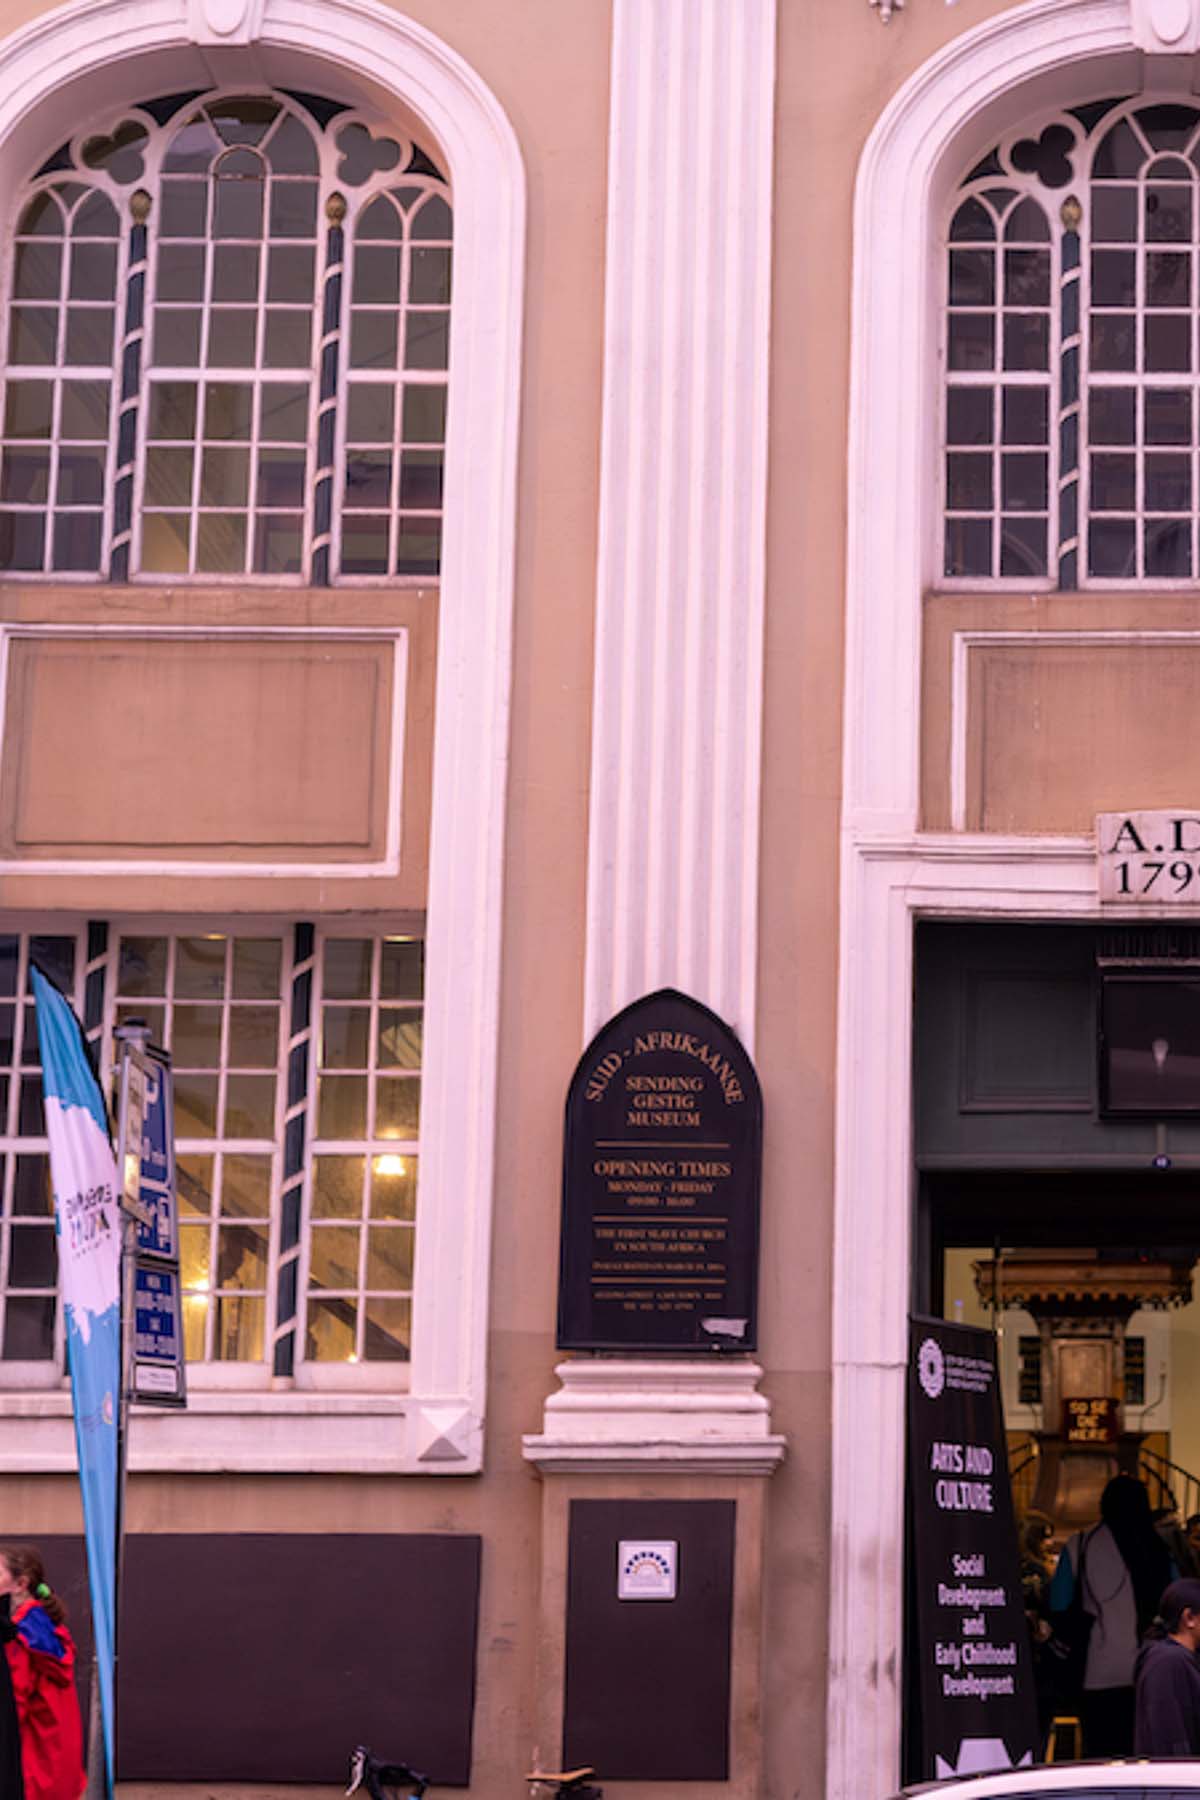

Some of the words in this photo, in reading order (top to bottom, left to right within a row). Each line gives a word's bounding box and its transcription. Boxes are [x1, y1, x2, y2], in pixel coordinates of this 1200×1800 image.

[584, 1052, 623, 1102] SUID
[633, 1031, 744, 1105] AFRIKAANSE
[625, 1076, 704, 1091] SENDING
[633, 1093, 695, 1109] GESTIG
[626, 1111, 700, 1127] MUSEUM
[593, 1160, 676, 1177] OPENING
[678, 1162, 732, 1177] TIMES
[607, 1181, 661, 1193] MONDAY
[670, 1182, 714, 1193] FRIDAY
[931, 1442, 964, 1473] ARTS
[965, 1445, 994, 1476] AND
[935, 1479, 994, 1512] CULTURE
[953, 1553, 985, 1577] Social
[938, 1583, 1006, 1611] Development
[962, 1613, 985, 1636] and
[935, 1642, 961, 1671] Early
[962, 1642, 1017, 1665] Childhood
[943, 1672, 1014, 1701] Development
